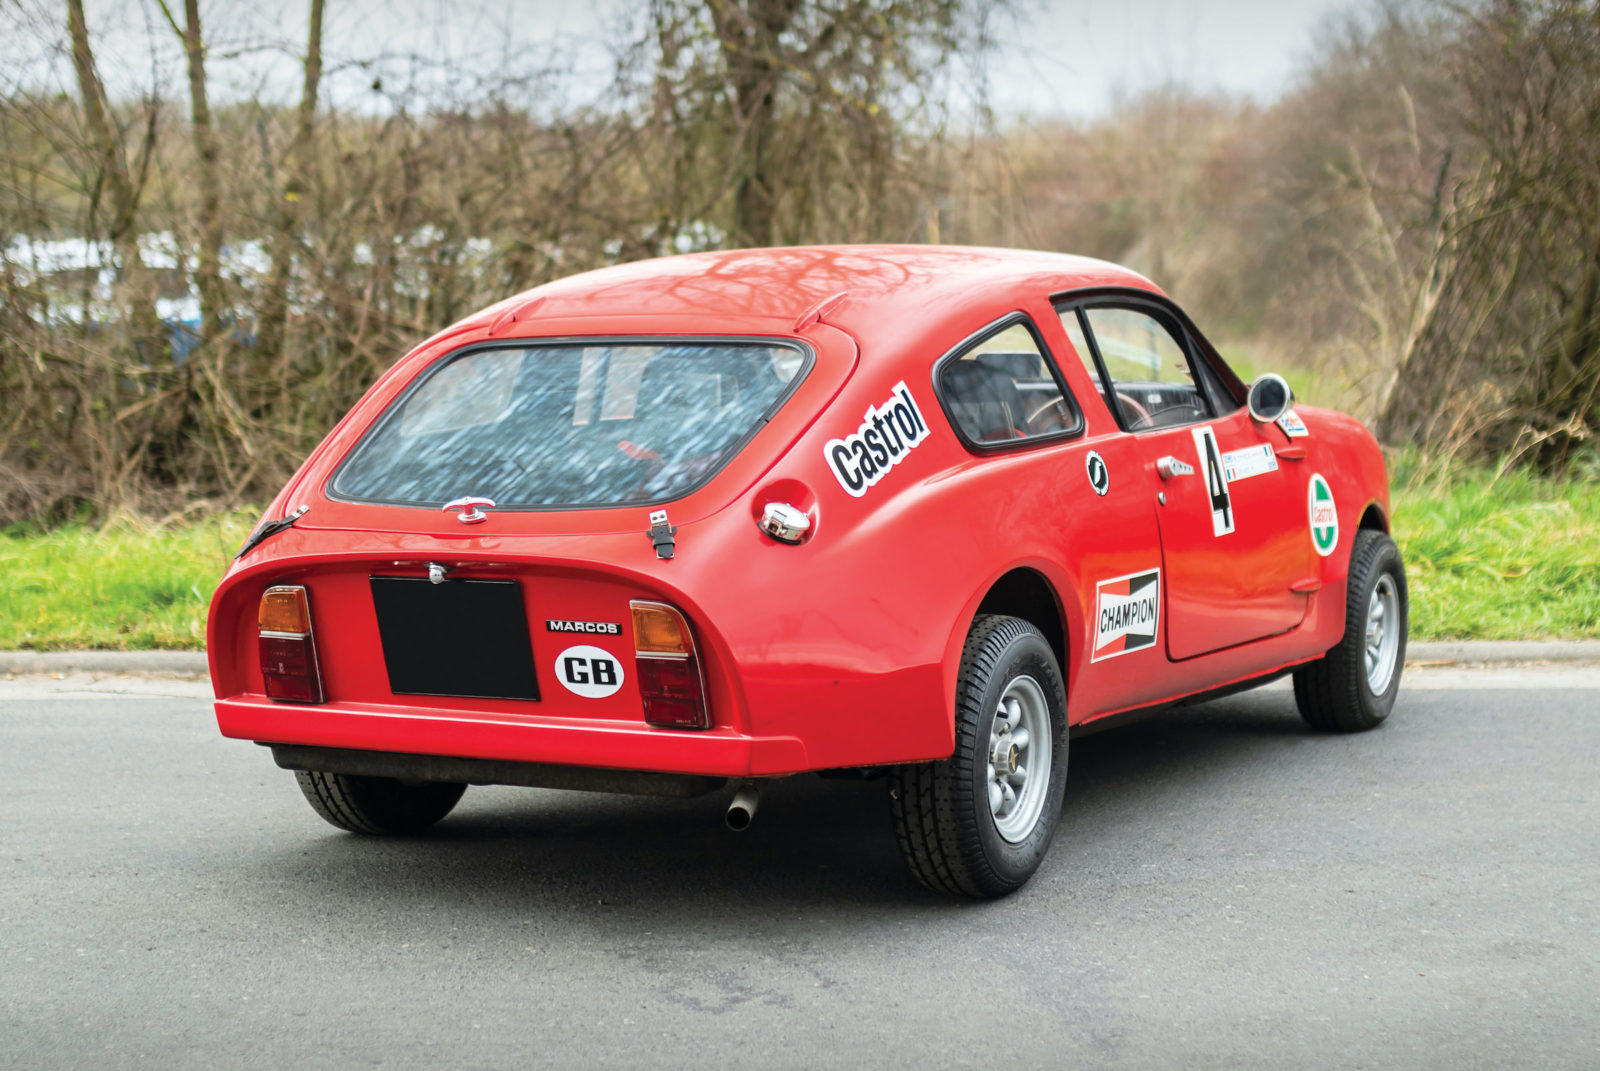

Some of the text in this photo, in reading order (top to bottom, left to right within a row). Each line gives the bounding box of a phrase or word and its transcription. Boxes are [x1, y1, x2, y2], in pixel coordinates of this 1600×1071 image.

[831, 389, 925, 491] Castrol
[1203, 433, 1230, 528] 4
[549, 621, 618, 634] MARCOS
[1100, 597, 1155, 634] CHAMPION
[563, 656, 618, 686] GB
